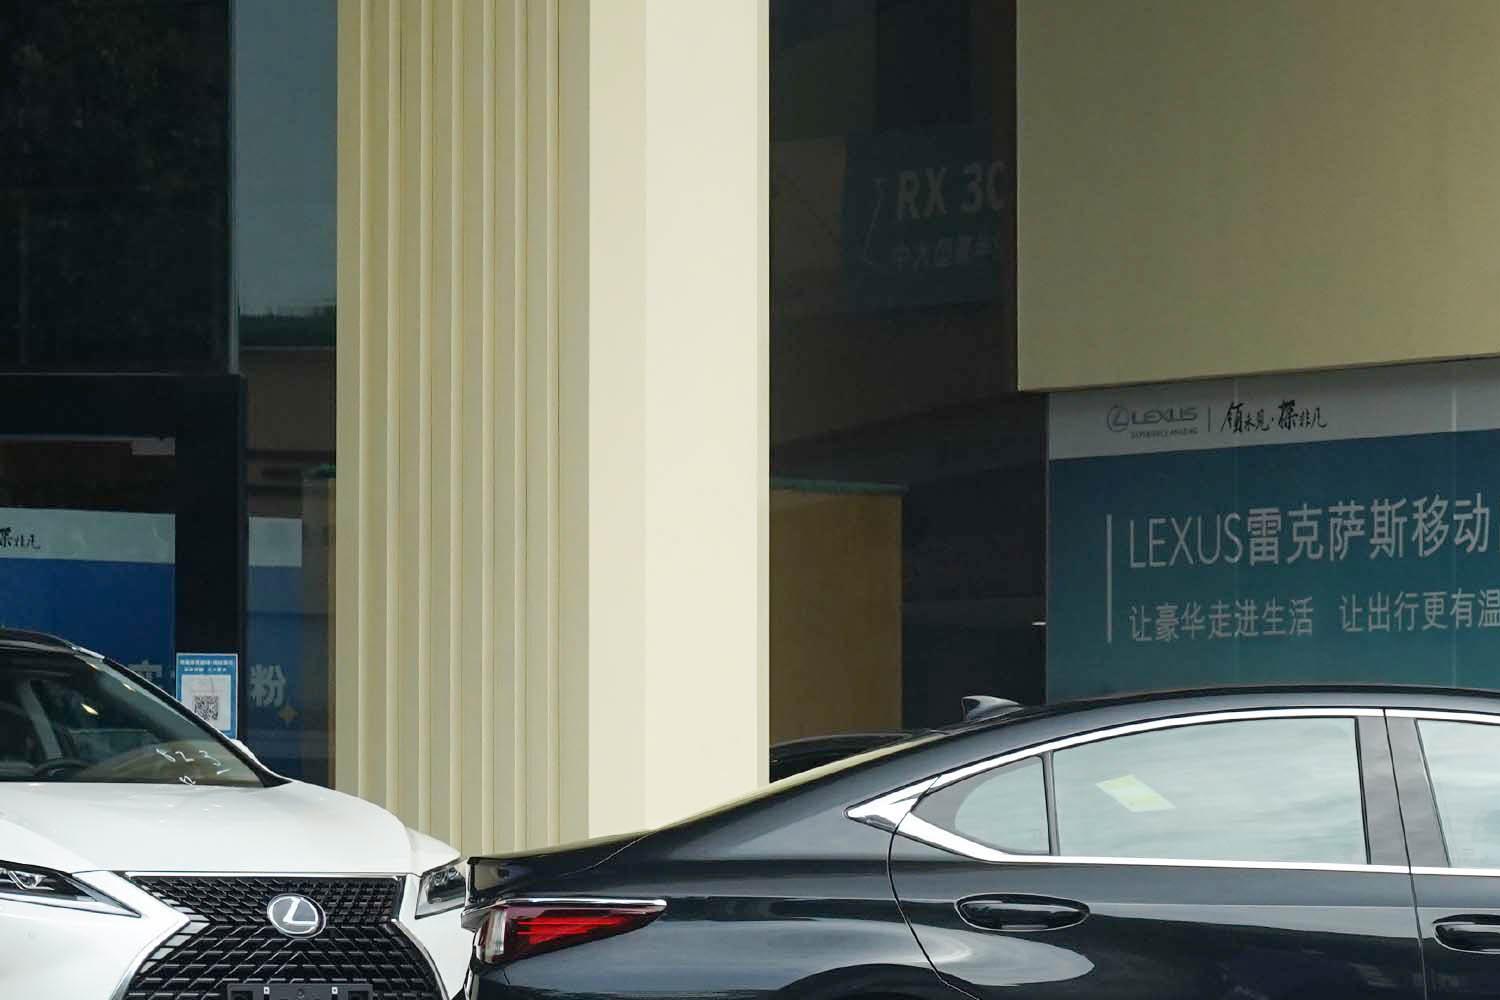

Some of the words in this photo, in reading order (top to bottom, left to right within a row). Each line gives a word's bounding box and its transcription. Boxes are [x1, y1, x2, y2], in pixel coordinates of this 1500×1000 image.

[1131, 407, 1198, 425] LEXUS
[1128, 597, 1314, 643] 让豪华走进生活
